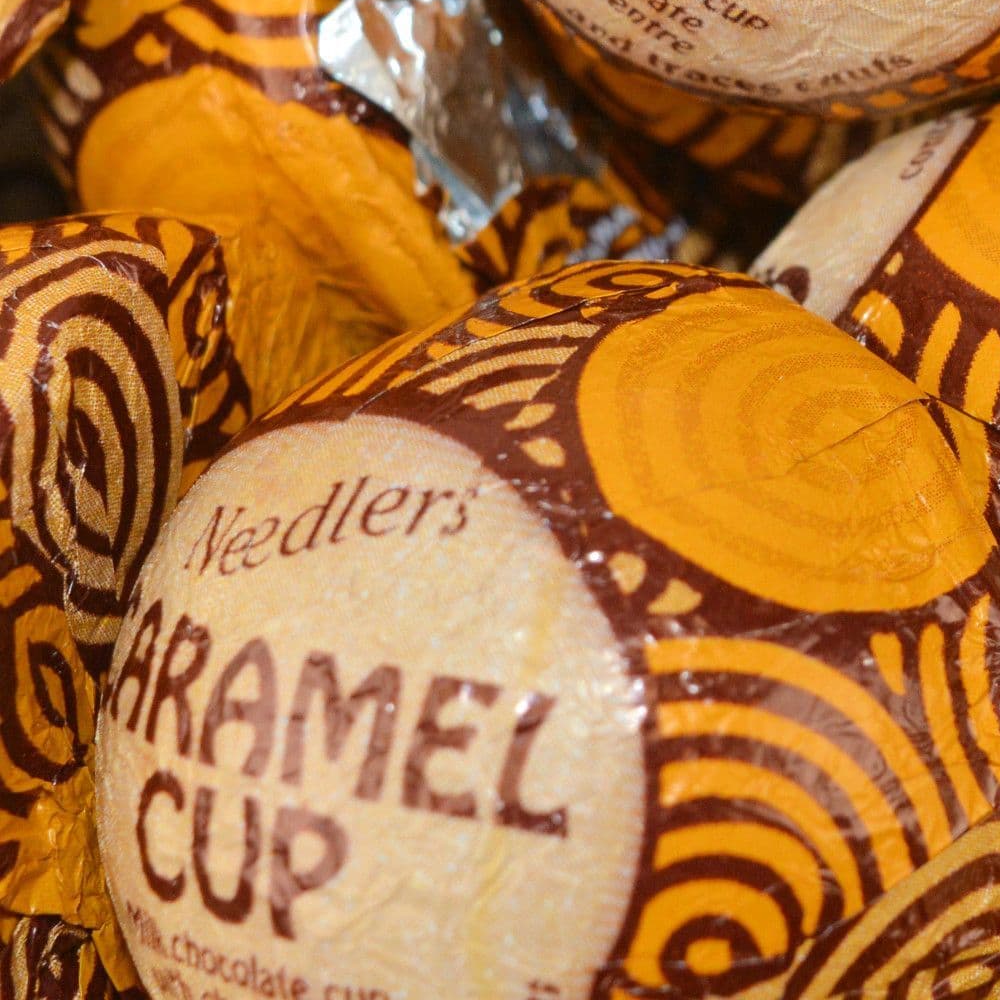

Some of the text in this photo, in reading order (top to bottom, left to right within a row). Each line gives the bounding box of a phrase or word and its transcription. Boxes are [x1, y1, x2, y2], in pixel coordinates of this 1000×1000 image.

[184, 475, 480, 578] Needlers
[103, 583, 569, 839] ARAMEL
[136, 768, 350, 941] CUP
